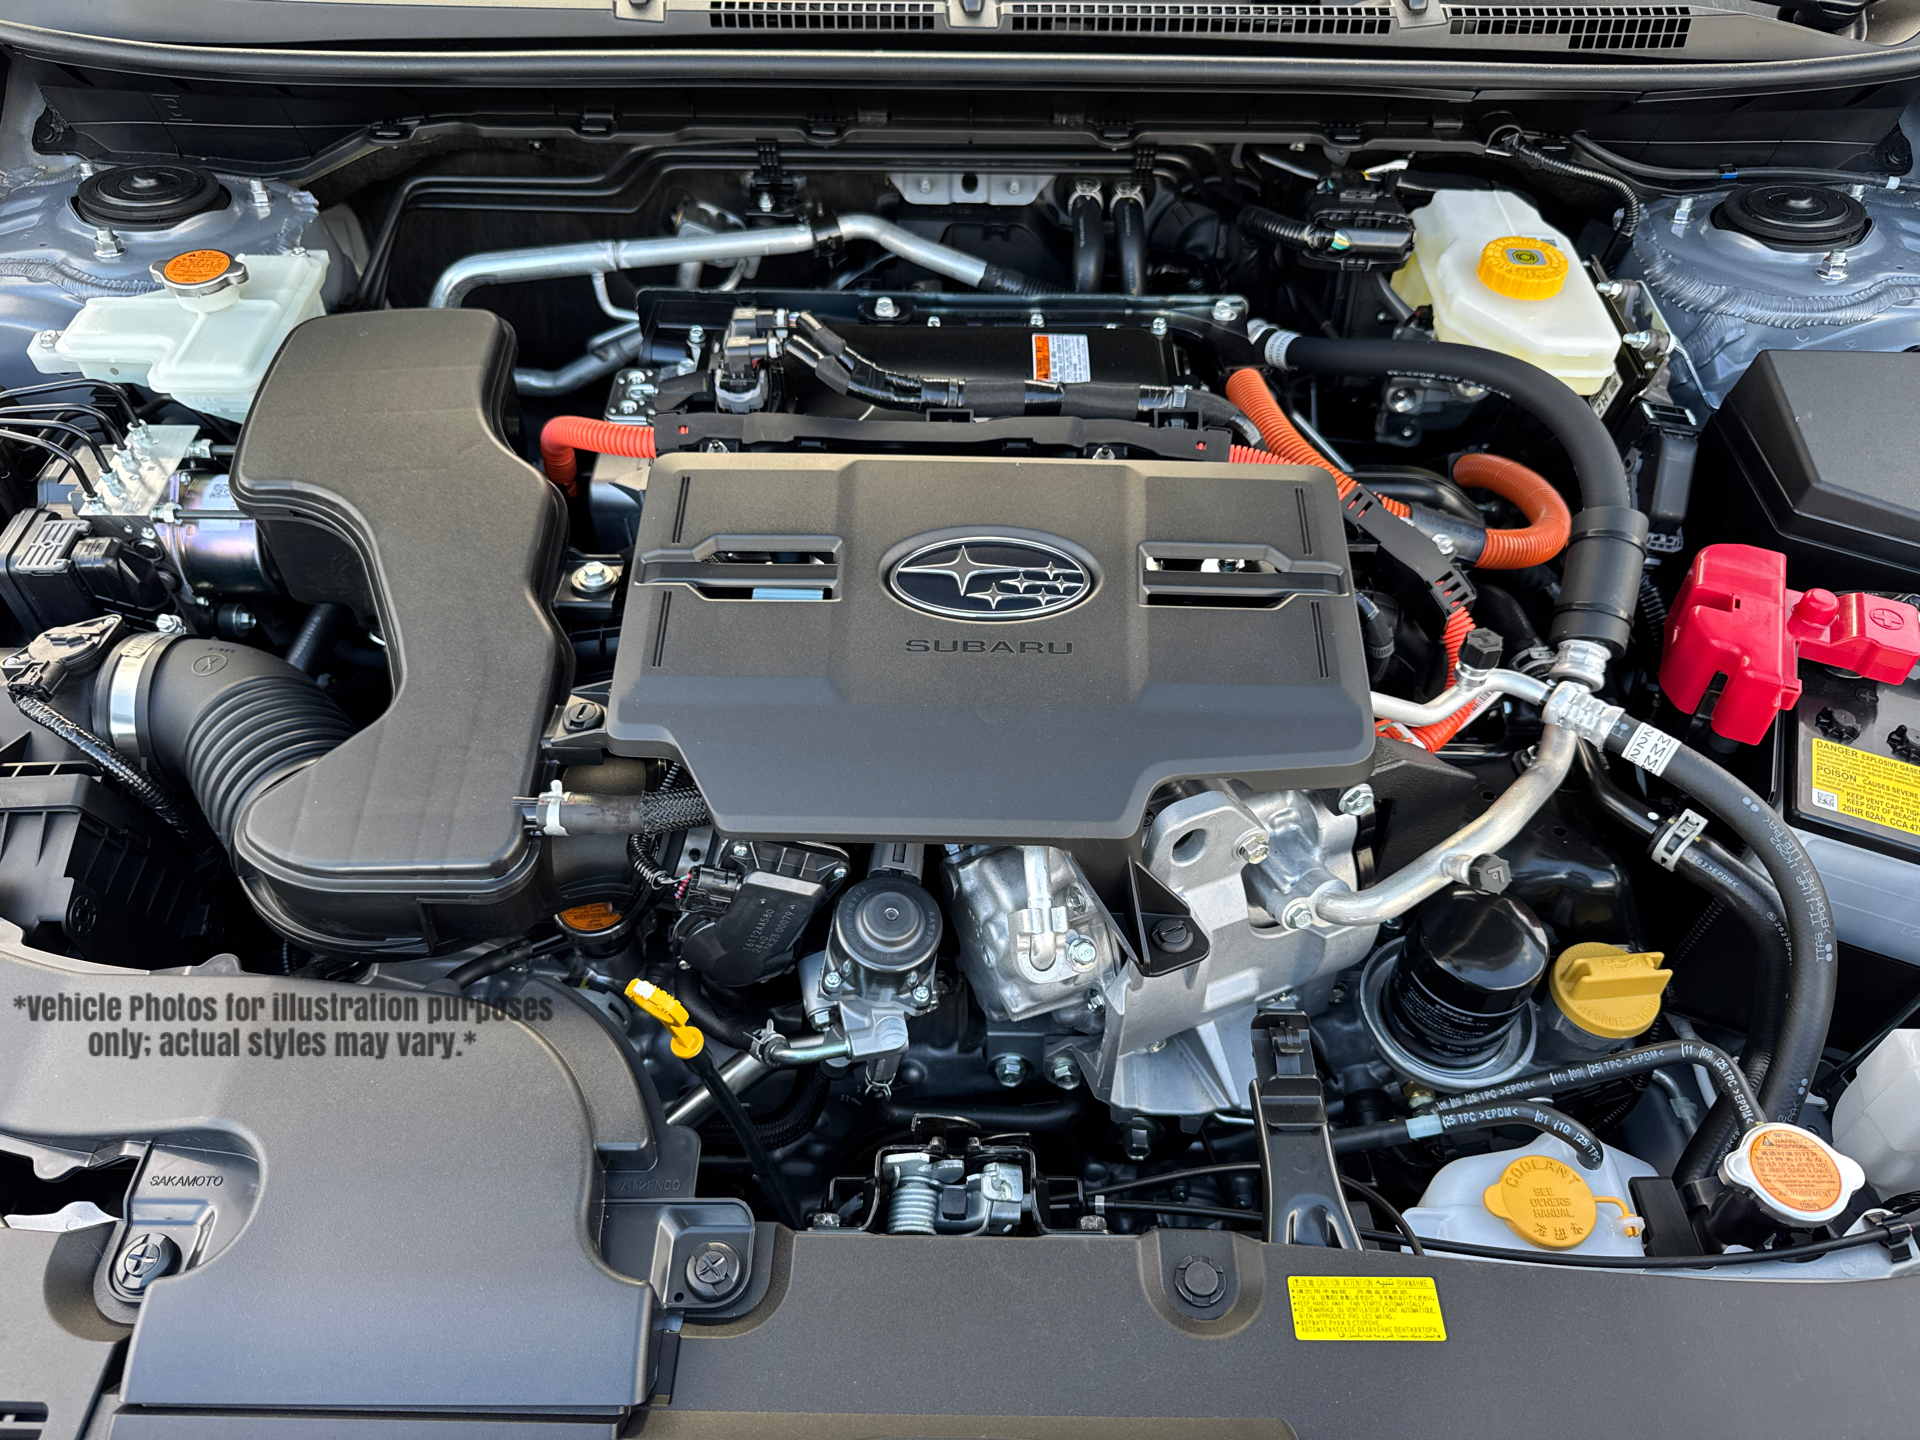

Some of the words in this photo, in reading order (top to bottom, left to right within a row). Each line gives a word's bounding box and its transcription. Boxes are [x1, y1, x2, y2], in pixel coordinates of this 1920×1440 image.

[906, 640, 1072, 654] SUBARU
[1817, 740, 1858, 758] DANGER
[1862, 753, 1898, 770] EXPLOSIVE
[1817, 765, 1856, 783] POISON
[1863, 778, 1890, 792] CAUSES
[1892, 786, 1918, 800] SEVERE
[1847, 791, 1864, 802] KEEP
[1866, 796, 1883, 807] VENT
[1886, 802, 1903, 813] CAPS
[1847, 798, 1864, 808] KEEP
[1866, 803, 1879, 812] OUT
[1882, 807, 1891, 816] OF
[1894, 811, 1917, 823] REACH
[1842, 803, 1864, 817] 20HR
[1865, 810, 1886, 823] 62Ah
[1890, 817, 1908, 830] CCA
[1479, 1090, 1497, 1101] TPC
[1604, 1059, 1623, 1071] TPC
[1722, 1070, 1737, 1087] TPC
[1457, 1112, 1477, 1123] TPC
[150, 1176, 224, 1186] SAKAMOTO
[1505, 1159, 1580, 1188] COOLANT
[1533, 1187, 1555, 1196] SEE
[1533, 1208, 1574, 1218] MANUAL
[1317, 1279, 1340, 1287] CAUTION
[1343, 1279, 1372, 1287] ATTENTION
